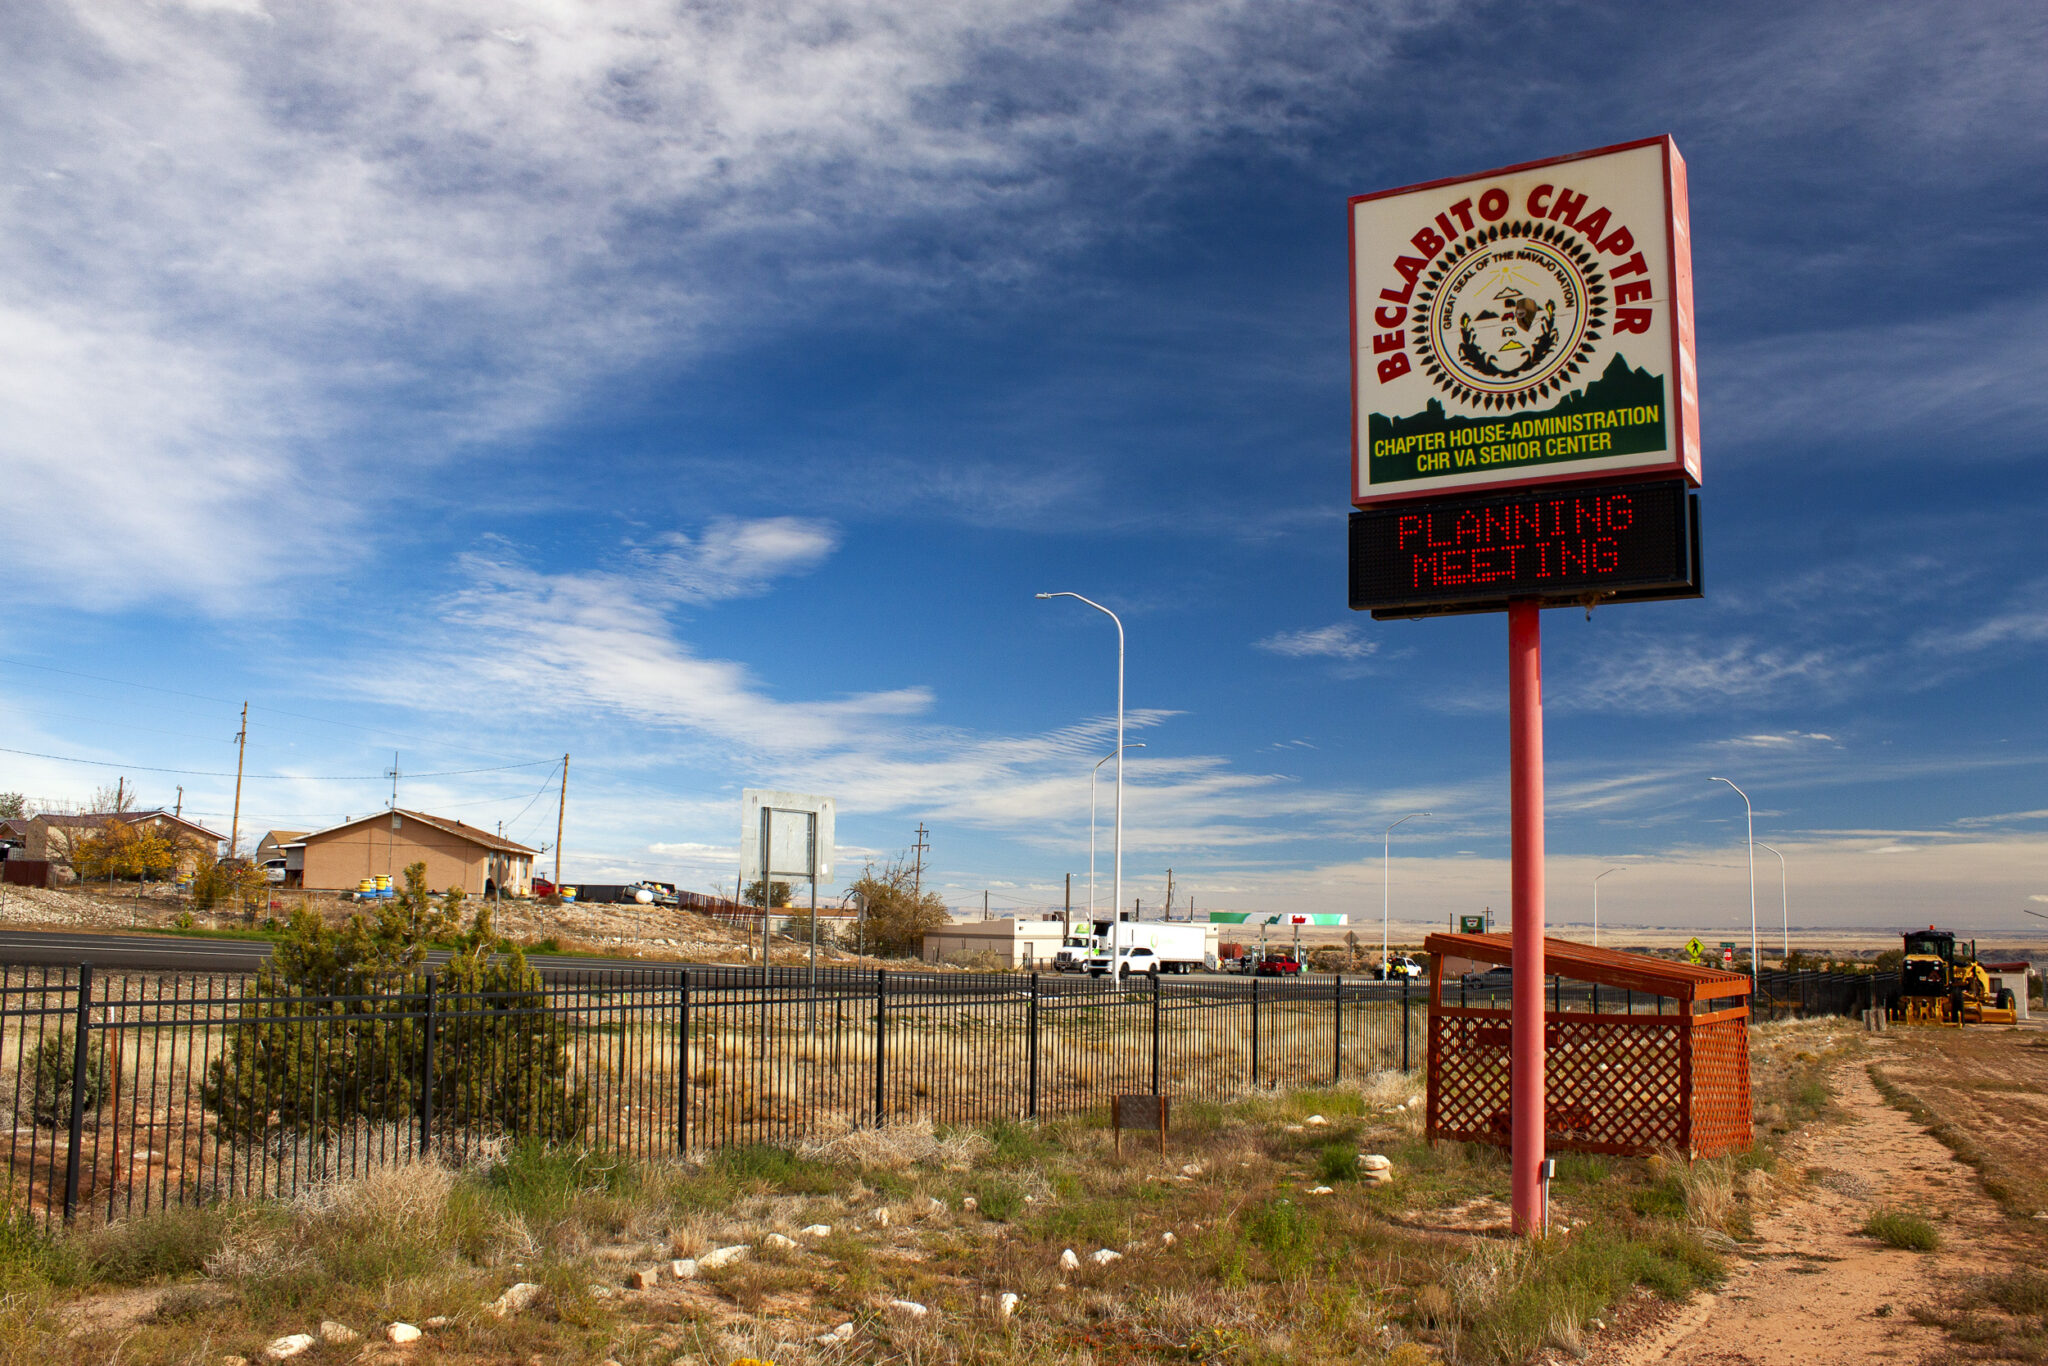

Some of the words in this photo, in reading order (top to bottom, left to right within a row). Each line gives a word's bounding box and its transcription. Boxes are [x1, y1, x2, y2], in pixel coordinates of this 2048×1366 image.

[1373, 188, 1509, 384] BECLABITO
[1526, 184, 1653, 336] CHAPTER
[1443, 295, 1457, 329] GREAT
[1453, 270, 1477, 293] SEAL
[1476, 258, 1490, 271] OF
[1492, 251, 1513, 262] THE
[1517, 251, 1556, 271] NAVAJO
[1554, 272, 1574, 307] NATION
[1374, 430, 1446, 458] CHAPTER
[1449, 405, 1659, 448] HOUSE-ADMINISTRATION
[1416, 450, 1451, 473] CHR
[1454, 447, 1476, 467] VA
[1479, 438, 1541, 465] SENIOR
[1548, 431, 1612, 457] CENTER
[1399, 494, 1633, 550] PLANNING
[1413, 537, 1619, 588] MEETING
